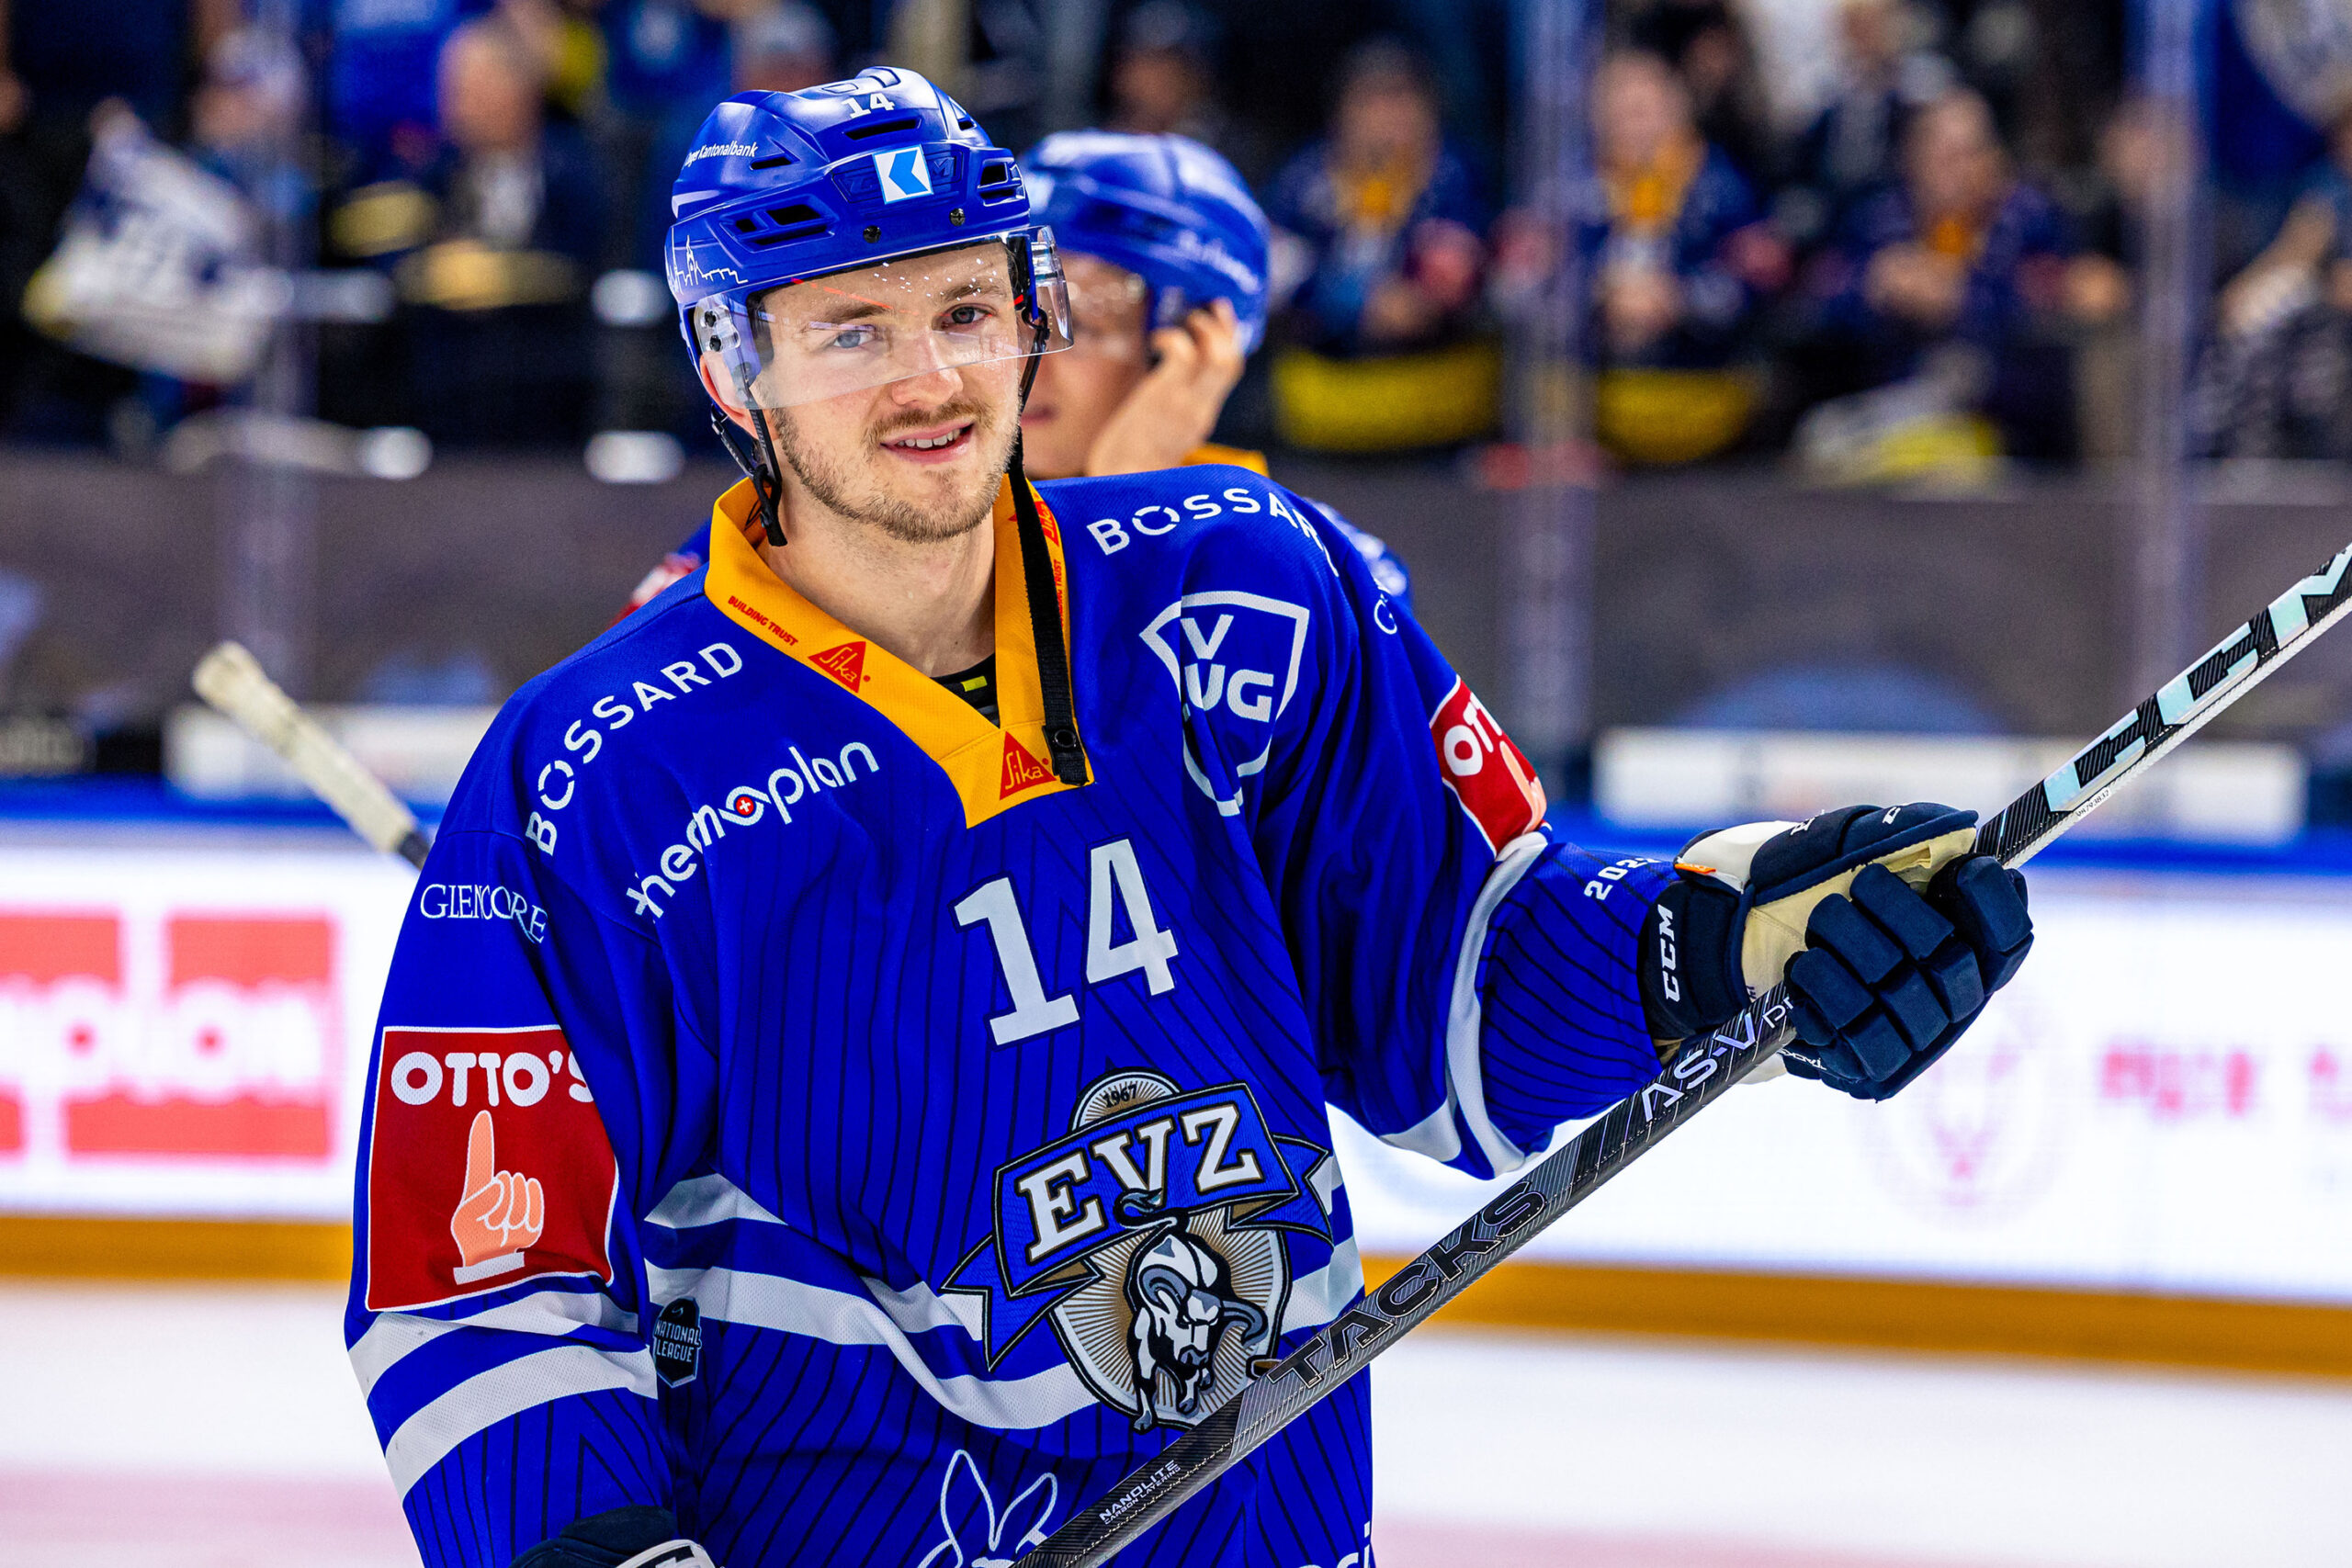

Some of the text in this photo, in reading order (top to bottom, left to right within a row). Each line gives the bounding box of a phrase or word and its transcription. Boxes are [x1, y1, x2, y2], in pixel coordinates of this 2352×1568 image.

[842, 93, 896, 119] 14
[697, 140, 758, 160] Kantonalbank
[728, 595, 798, 647] BUILDING TRUST
[1180, 614, 1235, 660] V
[819, 646, 859, 683] Sika
[1183, 662, 1274, 723] UG
[525, 641, 743, 856] BOSSARD
[1004, 750, 1044, 790] Sika
[419, 883, 549, 944] GLENCORE
[954, 838, 1180, 1046] 14
[1657, 903, 1681, 1003] CCM
[1641, 1011, 1757, 1122] AS-V
[1103, 1083, 1137, 1109] 1967
[1016, 1102, 1264, 1266] EVZ
[1266, 1179, 1546, 1390] TACKS
[654, 1320, 700, 1346] NATIONAL
[656, 1339, 695, 1362] LEAGUE
[1099, 1459, 1178, 1521] NANOLITE
[1104, 1468, 1181, 1525] CARBON LAYERING
